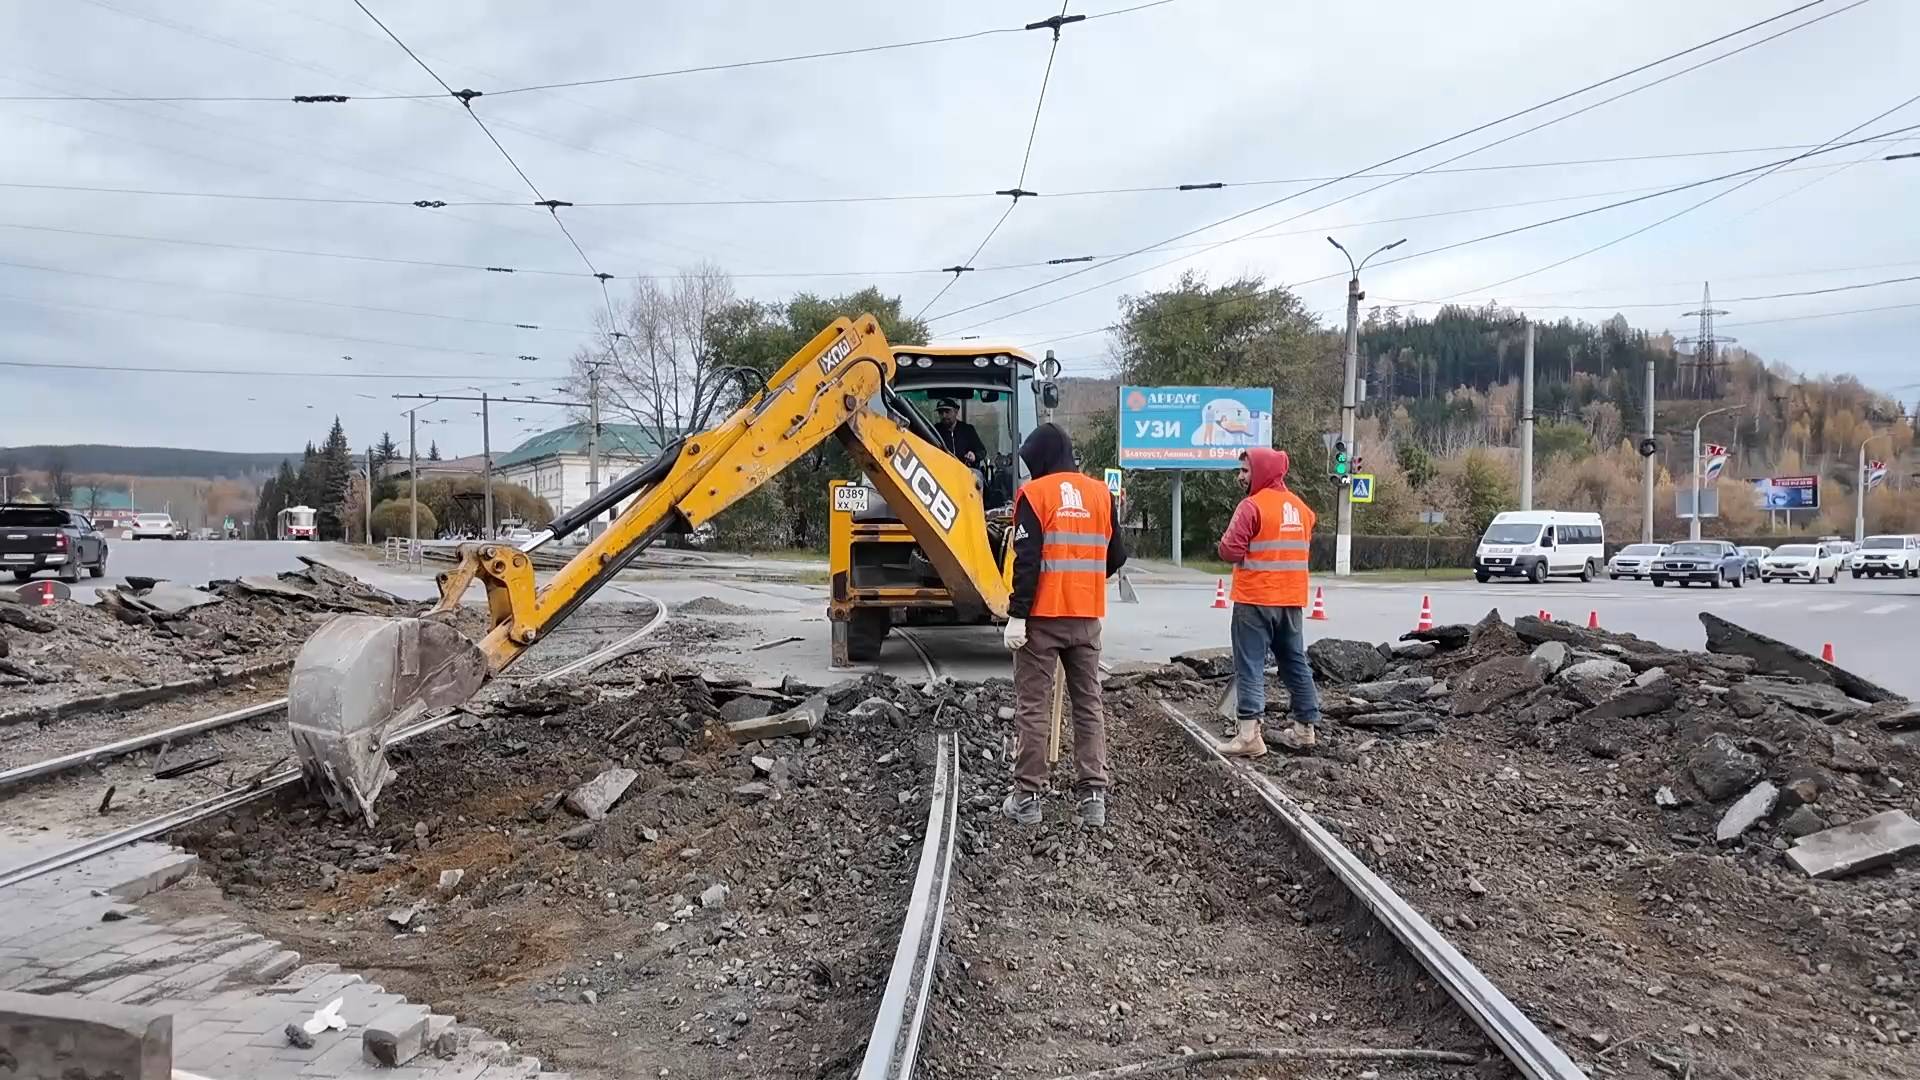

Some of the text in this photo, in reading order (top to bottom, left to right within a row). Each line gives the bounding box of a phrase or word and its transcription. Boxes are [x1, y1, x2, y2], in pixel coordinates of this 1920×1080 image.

[1134, 419, 1181, 439] УЗИ
[838, 488, 865, 500] 0389
[893, 454, 957, 530] JCB
[855, 501, 866, 510] 74
